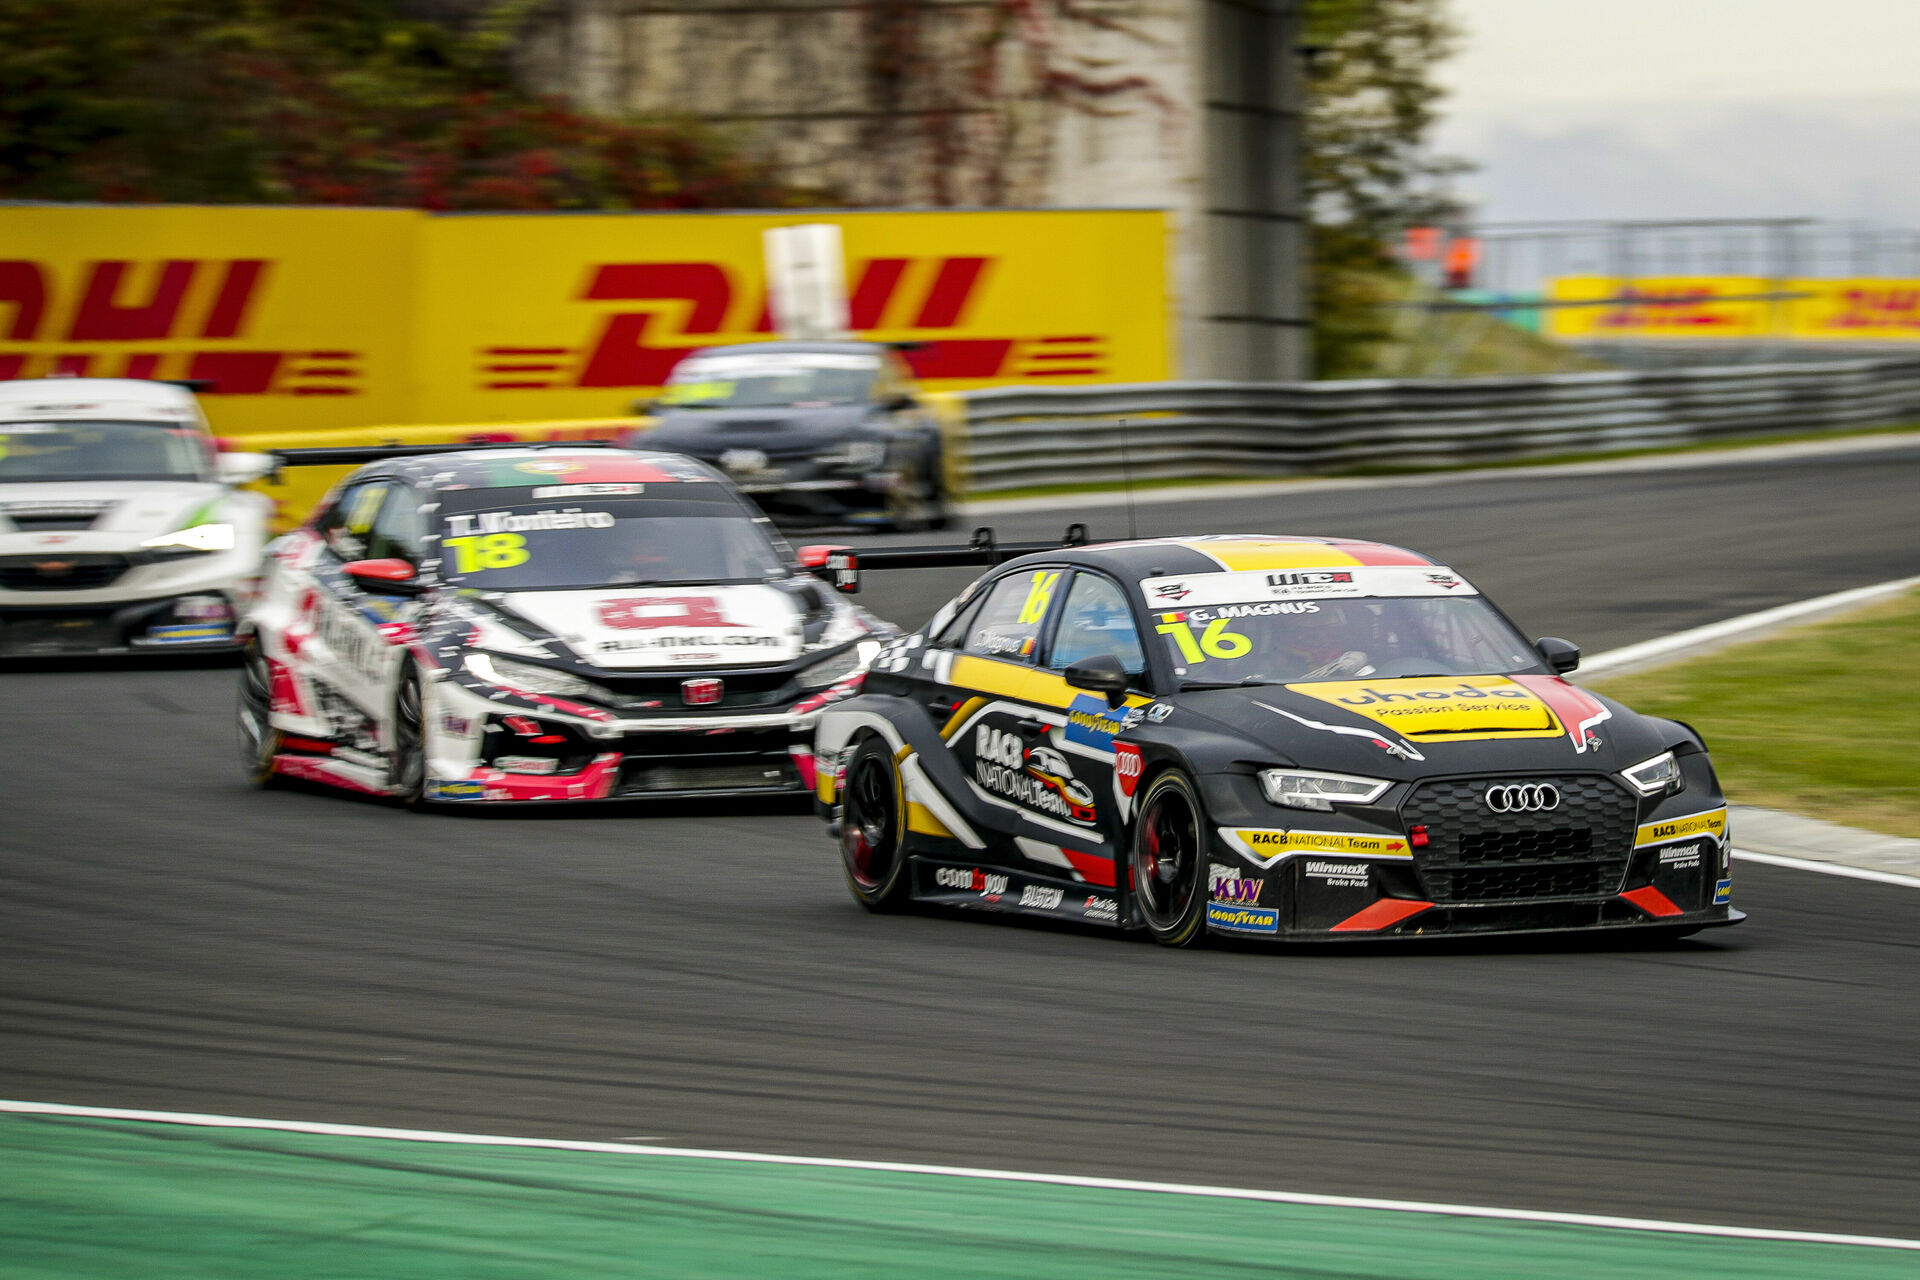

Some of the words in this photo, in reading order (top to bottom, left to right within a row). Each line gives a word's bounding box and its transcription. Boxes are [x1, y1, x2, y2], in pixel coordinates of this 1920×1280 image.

[442, 533, 531, 574] 18
[1017, 571, 1060, 624] 16
[1189, 610, 1217, 622] G.
[1217, 601, 1320, 618] MAGNUS
[1154, 619, 1252, 664] 16
[1338, 684, 1530, 705] uhoda
[1375, 704, 1454, 718] Passion
[1457, 702, 1532, 712] Service
[1252, 833, 1288, 846] RACB
[1288, 834, 1345, 848] NATIONAL
[1347, 838, 1380, 849] Team
[1214, 876, 1264, 903] KW
[1327, 878, 1349, 886] Brake
[1350, 878, 1369, 888] Pads
[1208, 909, 1274, 926] GOODYEAR
